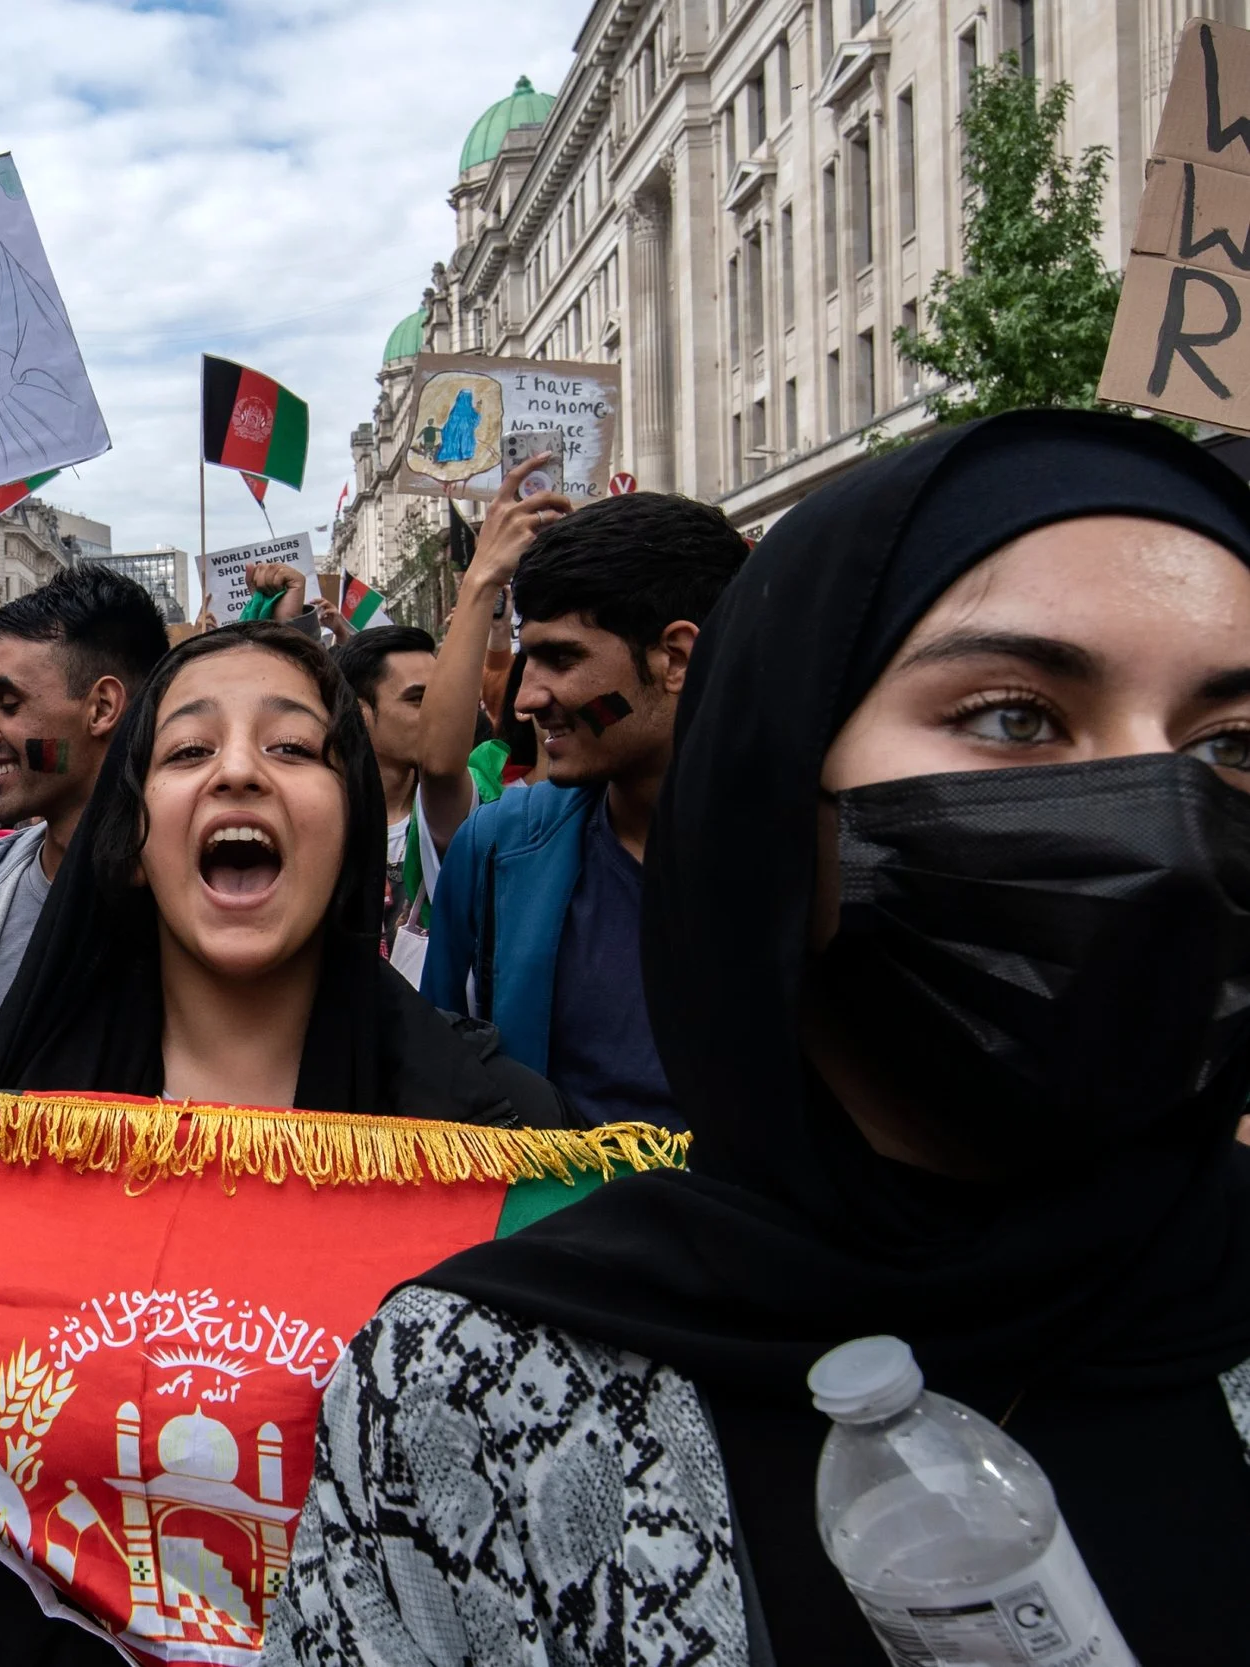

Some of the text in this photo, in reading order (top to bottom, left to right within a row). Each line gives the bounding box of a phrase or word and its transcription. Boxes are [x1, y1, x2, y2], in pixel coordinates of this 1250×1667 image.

[515, 375, 527, 390] I
[528, 399, 551, 411] no
[211, 539, 300, 566] WORLD LEADERS
